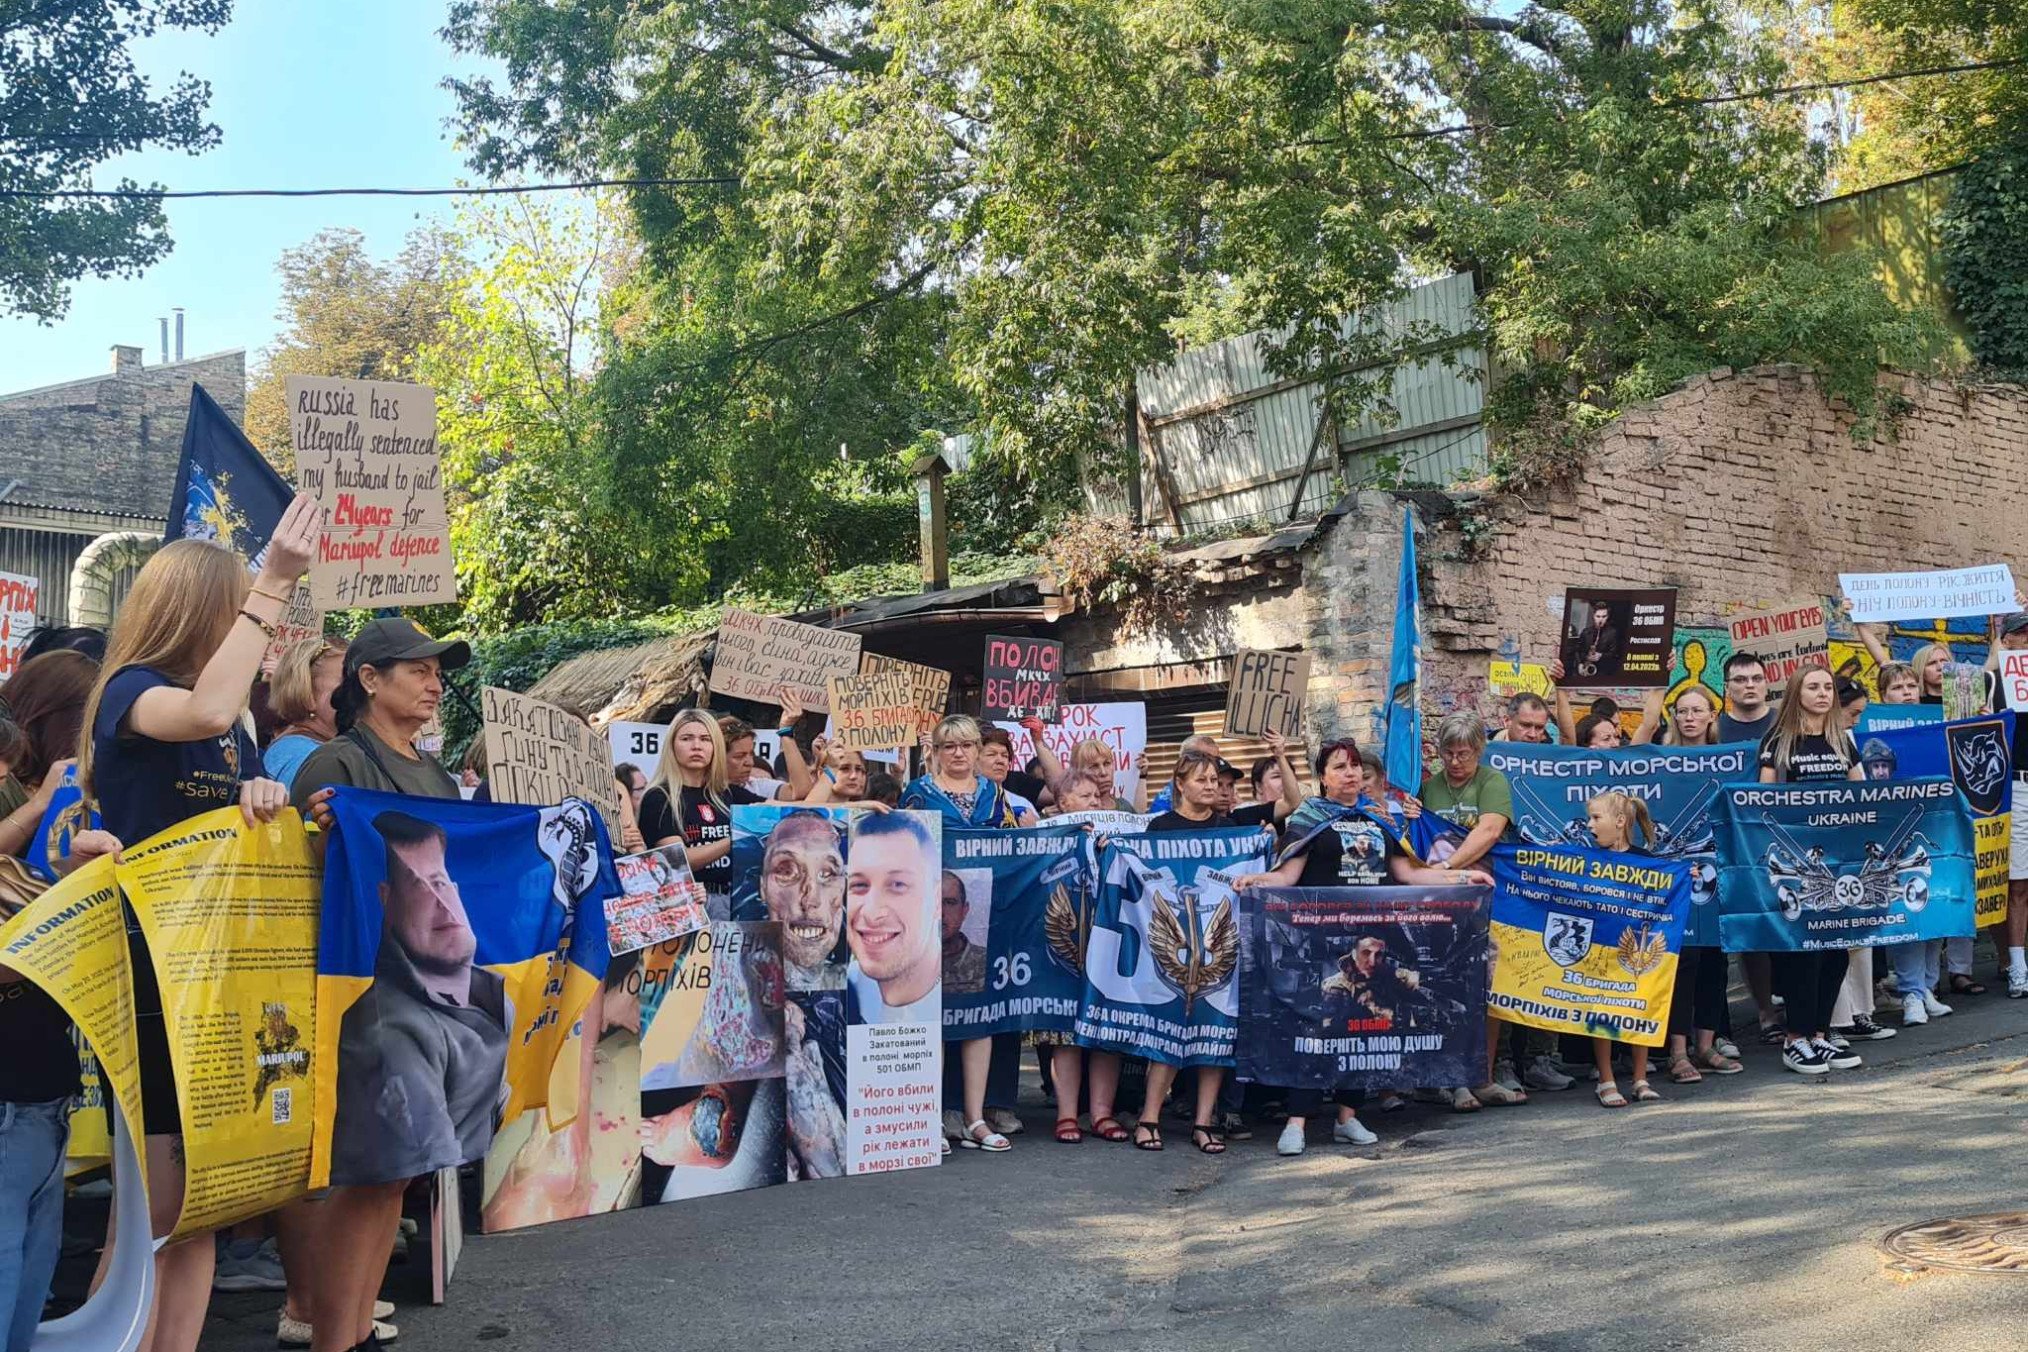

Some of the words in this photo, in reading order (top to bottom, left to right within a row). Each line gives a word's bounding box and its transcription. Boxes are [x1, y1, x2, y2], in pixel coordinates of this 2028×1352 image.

[370, 388, 399, 420] has
[297, 416, 363, 463] illegally
[370, 429, 437, 456] sentenced
[303, 468, 324, 500] my
[335, 458, 389, 490] husband
[396, 465, 408, 490] to
[409, 464, 438, 501] jail
[401, 499, 425, 531] for
[318, 530, 384, 573] Mariupol
[390, 531, 440, 568] defence
[1732, 615, 1770, 641] OPEN
[1799, 605, 1823, 629] EYES
[989, 641, 1060, 672] ПОЛОН
[723, 676, 739, 693] 36
[834, 673, 910, 693] ПОВЕРНІТЬ
[1015, 669, 1051, 682] МКЧХ
[1239, 652, 1298, 695] FREE
[843, 709, 865, 729] 36
[1229, 692, 1301, 738] ILLICHA
[631, 732, 659, 754] 36
[850, 724, 908, 746] ПОЛОНУ
[1490, 754, 1603, 778] ОРКЕСТР
[1608, 751, 1745, 777] МОРСЬКОЇ
[1790, 752, 1820, 765] Music
[1733, 790, 1855, 807] ORCHESTRA
[1860, 781, 1955, 802] MARINES
[1807, 811, 1878, 827] UKRAINE
[955, 834, 1013, 858] ВІРНИЙ
[1157, 837, 1228, 859] ПІХОТА
[1516, 849, 1585, 876] ВІРНИЙ
[1589, 860, 1674, 890] ЗАВЖДИ
[1837, 879, 1861, 899] 36
[6, 886, 115, 954] INFORMATION
[1808, 919, 1849, 930] MARINE
[1852, 913, 1906, 928] BRIGADE
[993, 952, 1032, 990] 36
[1562, 970, 1583, 986] 36
[1584, 976, 1637, 992] БРИГАДА
[1542, 987, 1604, 1005] МОРСЬКОЇ
[1603, 995, 1646, 1010] ПІХОТИ
[942, 1001, 1006, 1026] БРИГАДА
[1571, 1009, 1582, 1022] З
[1584, 1011, 1659, 1034] ПОЛОНУ
[869, 1027, 896, 1037] Павло
[898, 1026, 927, 1036] Божко
[1110, 1009, 1156, 1029] ОКРЕМА
[1156, 1019, 1198, 1041] БРИГАДА
[869, 1037, 926, 1049] Закатований
[1294, 1036, 1366, 1055] ПОВЕРНІТЬ
[1367, 1036, 1401, 1052] МОЮ
[1404, 1034, 1443, 1053] ДУШУ
[256, 1051, 304, 1067] MARIUPOL
[869, 1053, 899, 1063] полоні
[903, 1050, 933, 1063] морпіх
[1338, 1056, 1348, 1071] З
[1349, 1053, 1401, 1071] ПОЛОНУ
[876, 1064, 893, 1074] 501
[894, 1063, 921, 1073] ОБМП
[898, 1084, 934, 1096] вбили
[853, 1109, 860, 1117] в
[864, 1103, 904, 1117] полоні
[908, 1101, 939, 1115] чужі,
[864, 1126, 872, 1135] а
[875, 1120, 928, 1137] змусили
[863, 1141, 881, 1155] рік
[885, 1138, 930, 1151] лежати
[859, 1162, 865, 1172] в
[869, 1156, 904, 1173] морзі
